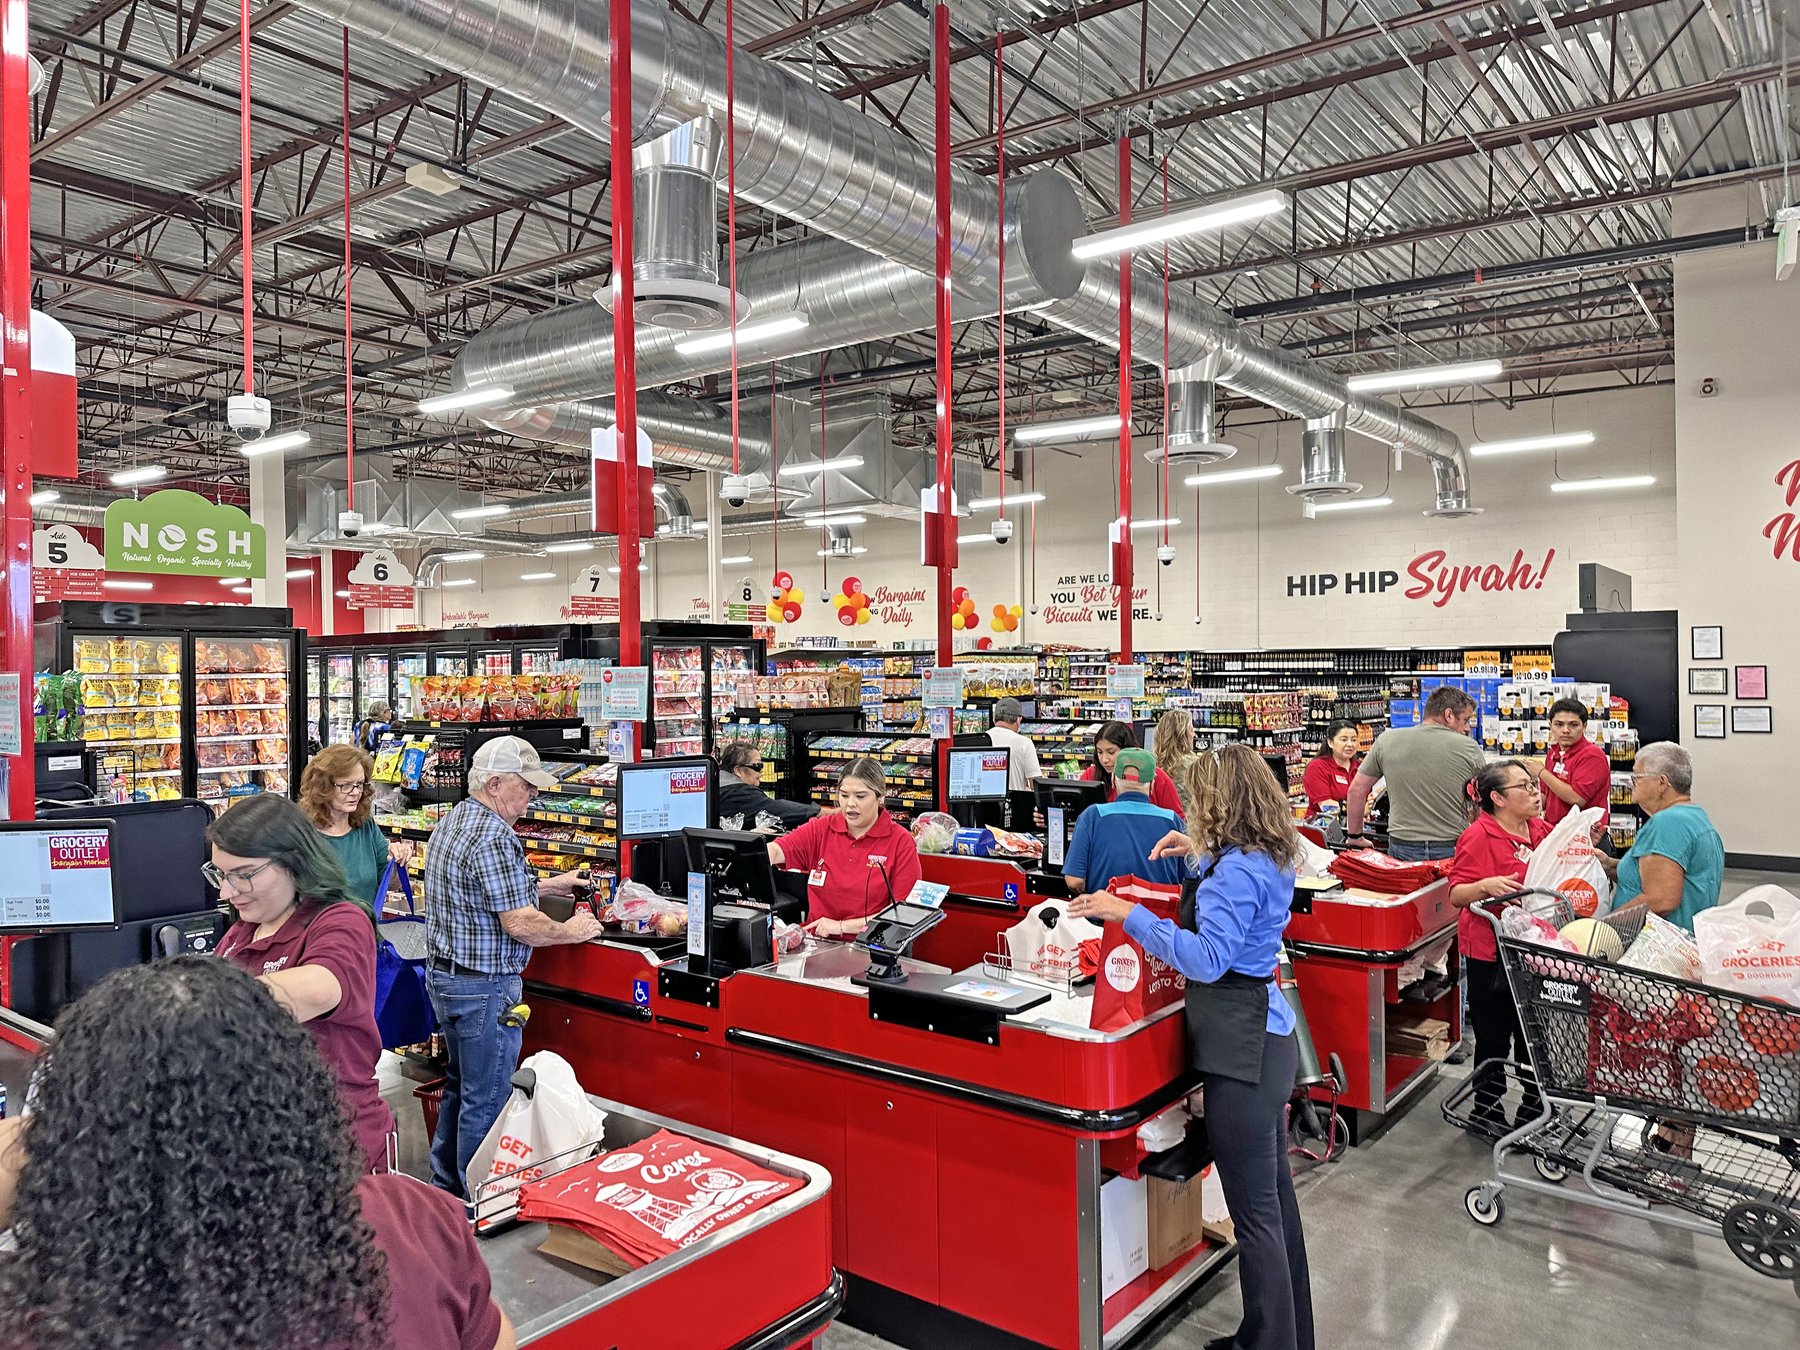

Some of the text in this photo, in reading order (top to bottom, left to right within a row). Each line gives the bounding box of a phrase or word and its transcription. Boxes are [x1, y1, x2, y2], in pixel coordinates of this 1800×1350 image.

[123, 521, 251, 556] NOSH
[48, 542, 68, 564] 5
[122, 551, 252, 570] Natural Organic Specialty Healthy
[373, 563, 389, 582] 6
[1057, 575, 1077, 585] ARE
[1079, 574, 1095, 583] WE
[1286, 547, 1556, 608] HIP HIP Syrah!
[589, 577, 600, 593] 7
[742, 587, 752, 601] 8
[875, 585, 926, 608] Bargains
[1050, 584, 1148, 608] YOU Bet Yur
[692, 598, 711, 611] Today
[880, 605, 913, 628] Daily.
[1042, 605, 1153, 624] Biscuits WE RE.
[671, 771, 706, 780] GROCERY
[675, 779, 701, 788] OUTLET
[50, 836, 108, 849] GROCERY
[59, 847, 100, 860] OUTLET
[52, 857, 83, 869] bargain
[1046, 943, 1066, 958] GET
[1111, 957, 1137, 967] GROCERY
[1721, 955, 1800, 969] GROCERIES
[1115, 965, 1133, 975] OUTLET
[1542, 979, 1579, 994] GROCERY
[499, 1135, 533, 1159] GET
[640, 1150, 712, 1184] Ceres
[678, 1218, 717, 1249] LOCALLY
[715, 1202, 746, 1221] OWNED
